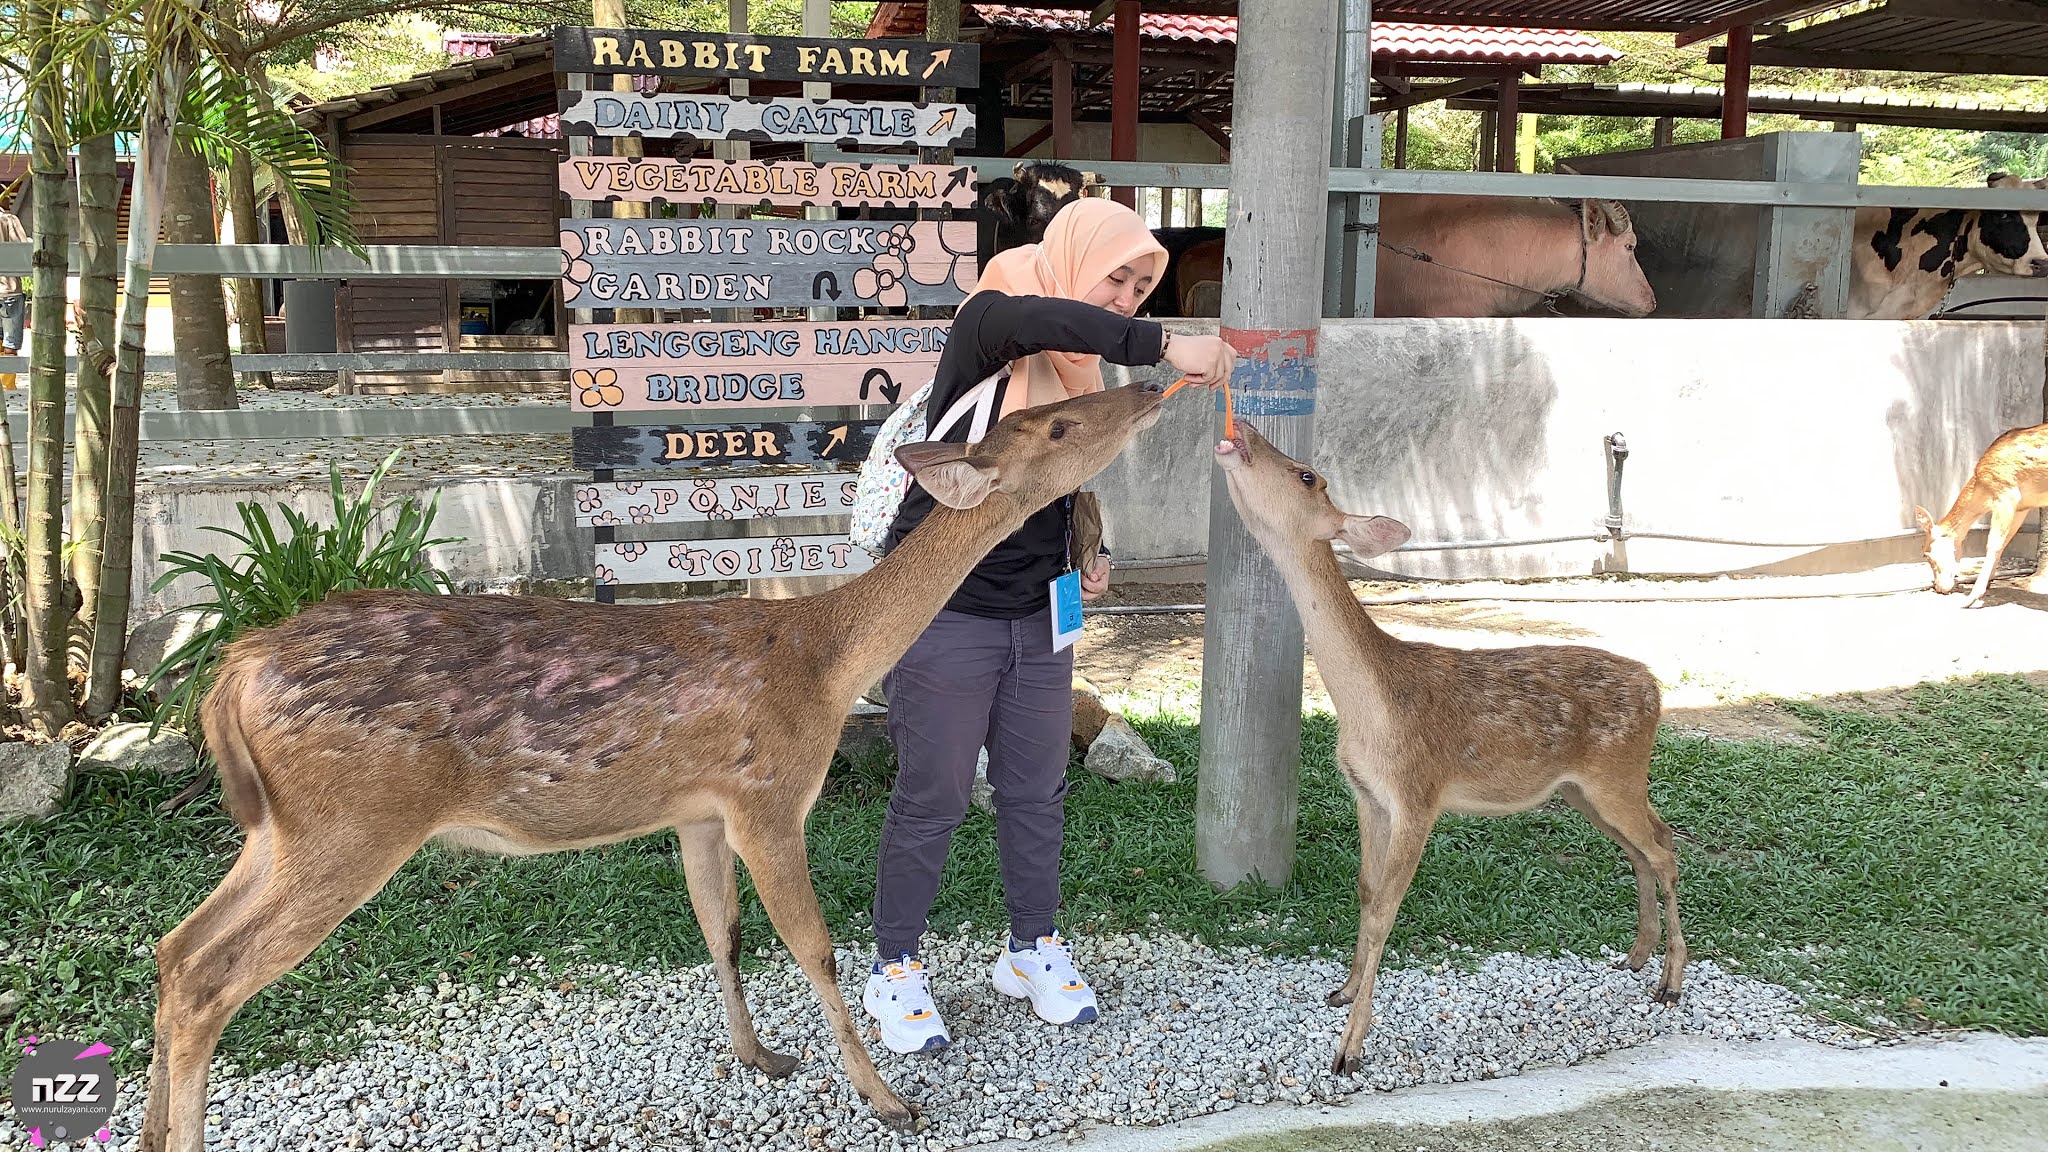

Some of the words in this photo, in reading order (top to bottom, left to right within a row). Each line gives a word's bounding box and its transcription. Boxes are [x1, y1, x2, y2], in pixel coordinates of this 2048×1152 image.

[592, 37, 771, 73] RABBIT
[797, 46, 910, 76] FARM
[594, 98, 730, 133] DAIRY
[761, 106, 916, 136] CATTLE
[572, 161, 819, 195] VEGETABLE
[832, 168, 937, 198] FARM
[584, 227, 754, 255] RABBIT
[768, 227, 875, 254] ROCK
[590, 273, 774, 300] GARDEN
[583, 331, 800, 359] LENGGENG
[815, 326, 951, 355] HANGIN
[646, 373, 804, 403] BRIDGE
[664, 431, 780, 459] DEER
[651, 481, 857, 513] PONIES
[687, 543, 852, 576] TOILET
